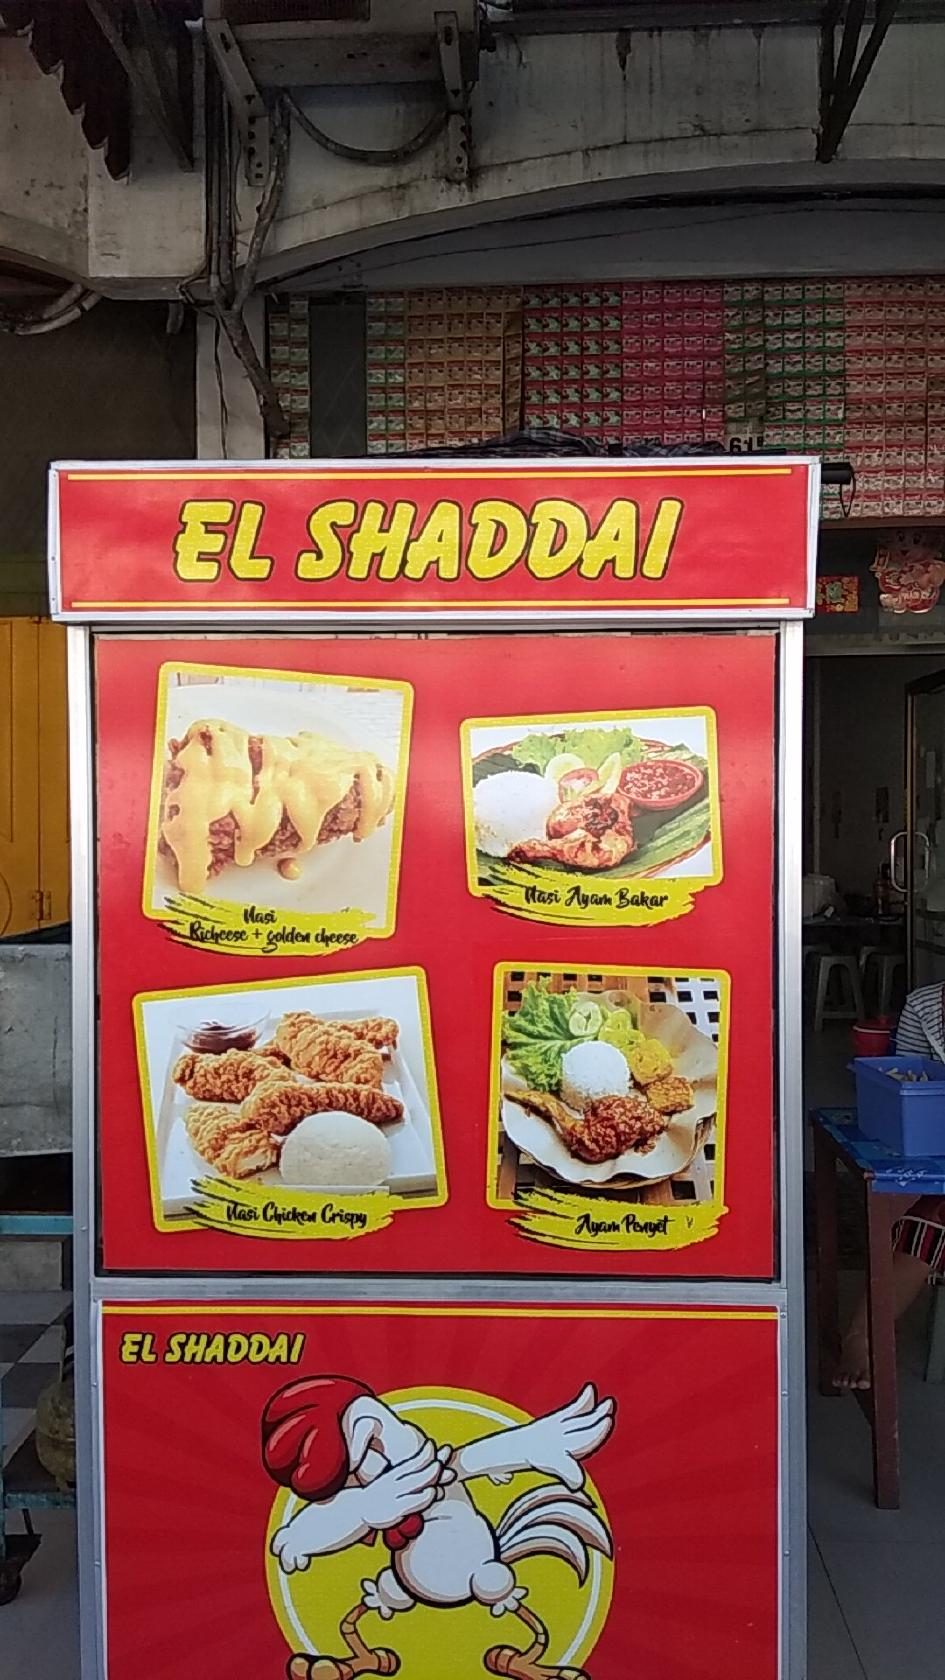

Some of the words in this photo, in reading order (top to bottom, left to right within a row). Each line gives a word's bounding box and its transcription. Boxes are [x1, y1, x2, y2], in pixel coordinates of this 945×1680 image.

[174, 499, 272, 582] EL
[296, 498, 683, 582] SHADDAI
[524, 886, 561, 905] Nasi
[565, 885, 613, 909] Ayam
[615, 887, 669, 910] Bakar
[243, 906, 277, 924] Nasi
[188, 920, 248, 943] Richeese
[251, 928, 263, 940] +
[261, 925, 311, 953] golden
[314, 931, 358, 948] cheese
[226, 1202, 260, 1222] Nasi
[262, 1201, 317, 1226] Chicken
[320, 1202, 368, 1229] Crispy
[575, 1213, 620, 1237] Ayam
[621, 1213, 675, 1238] Penyet
[120, 1332, 158, 1364] EL
[163, 1332, 306, 1365] SHADDAI
